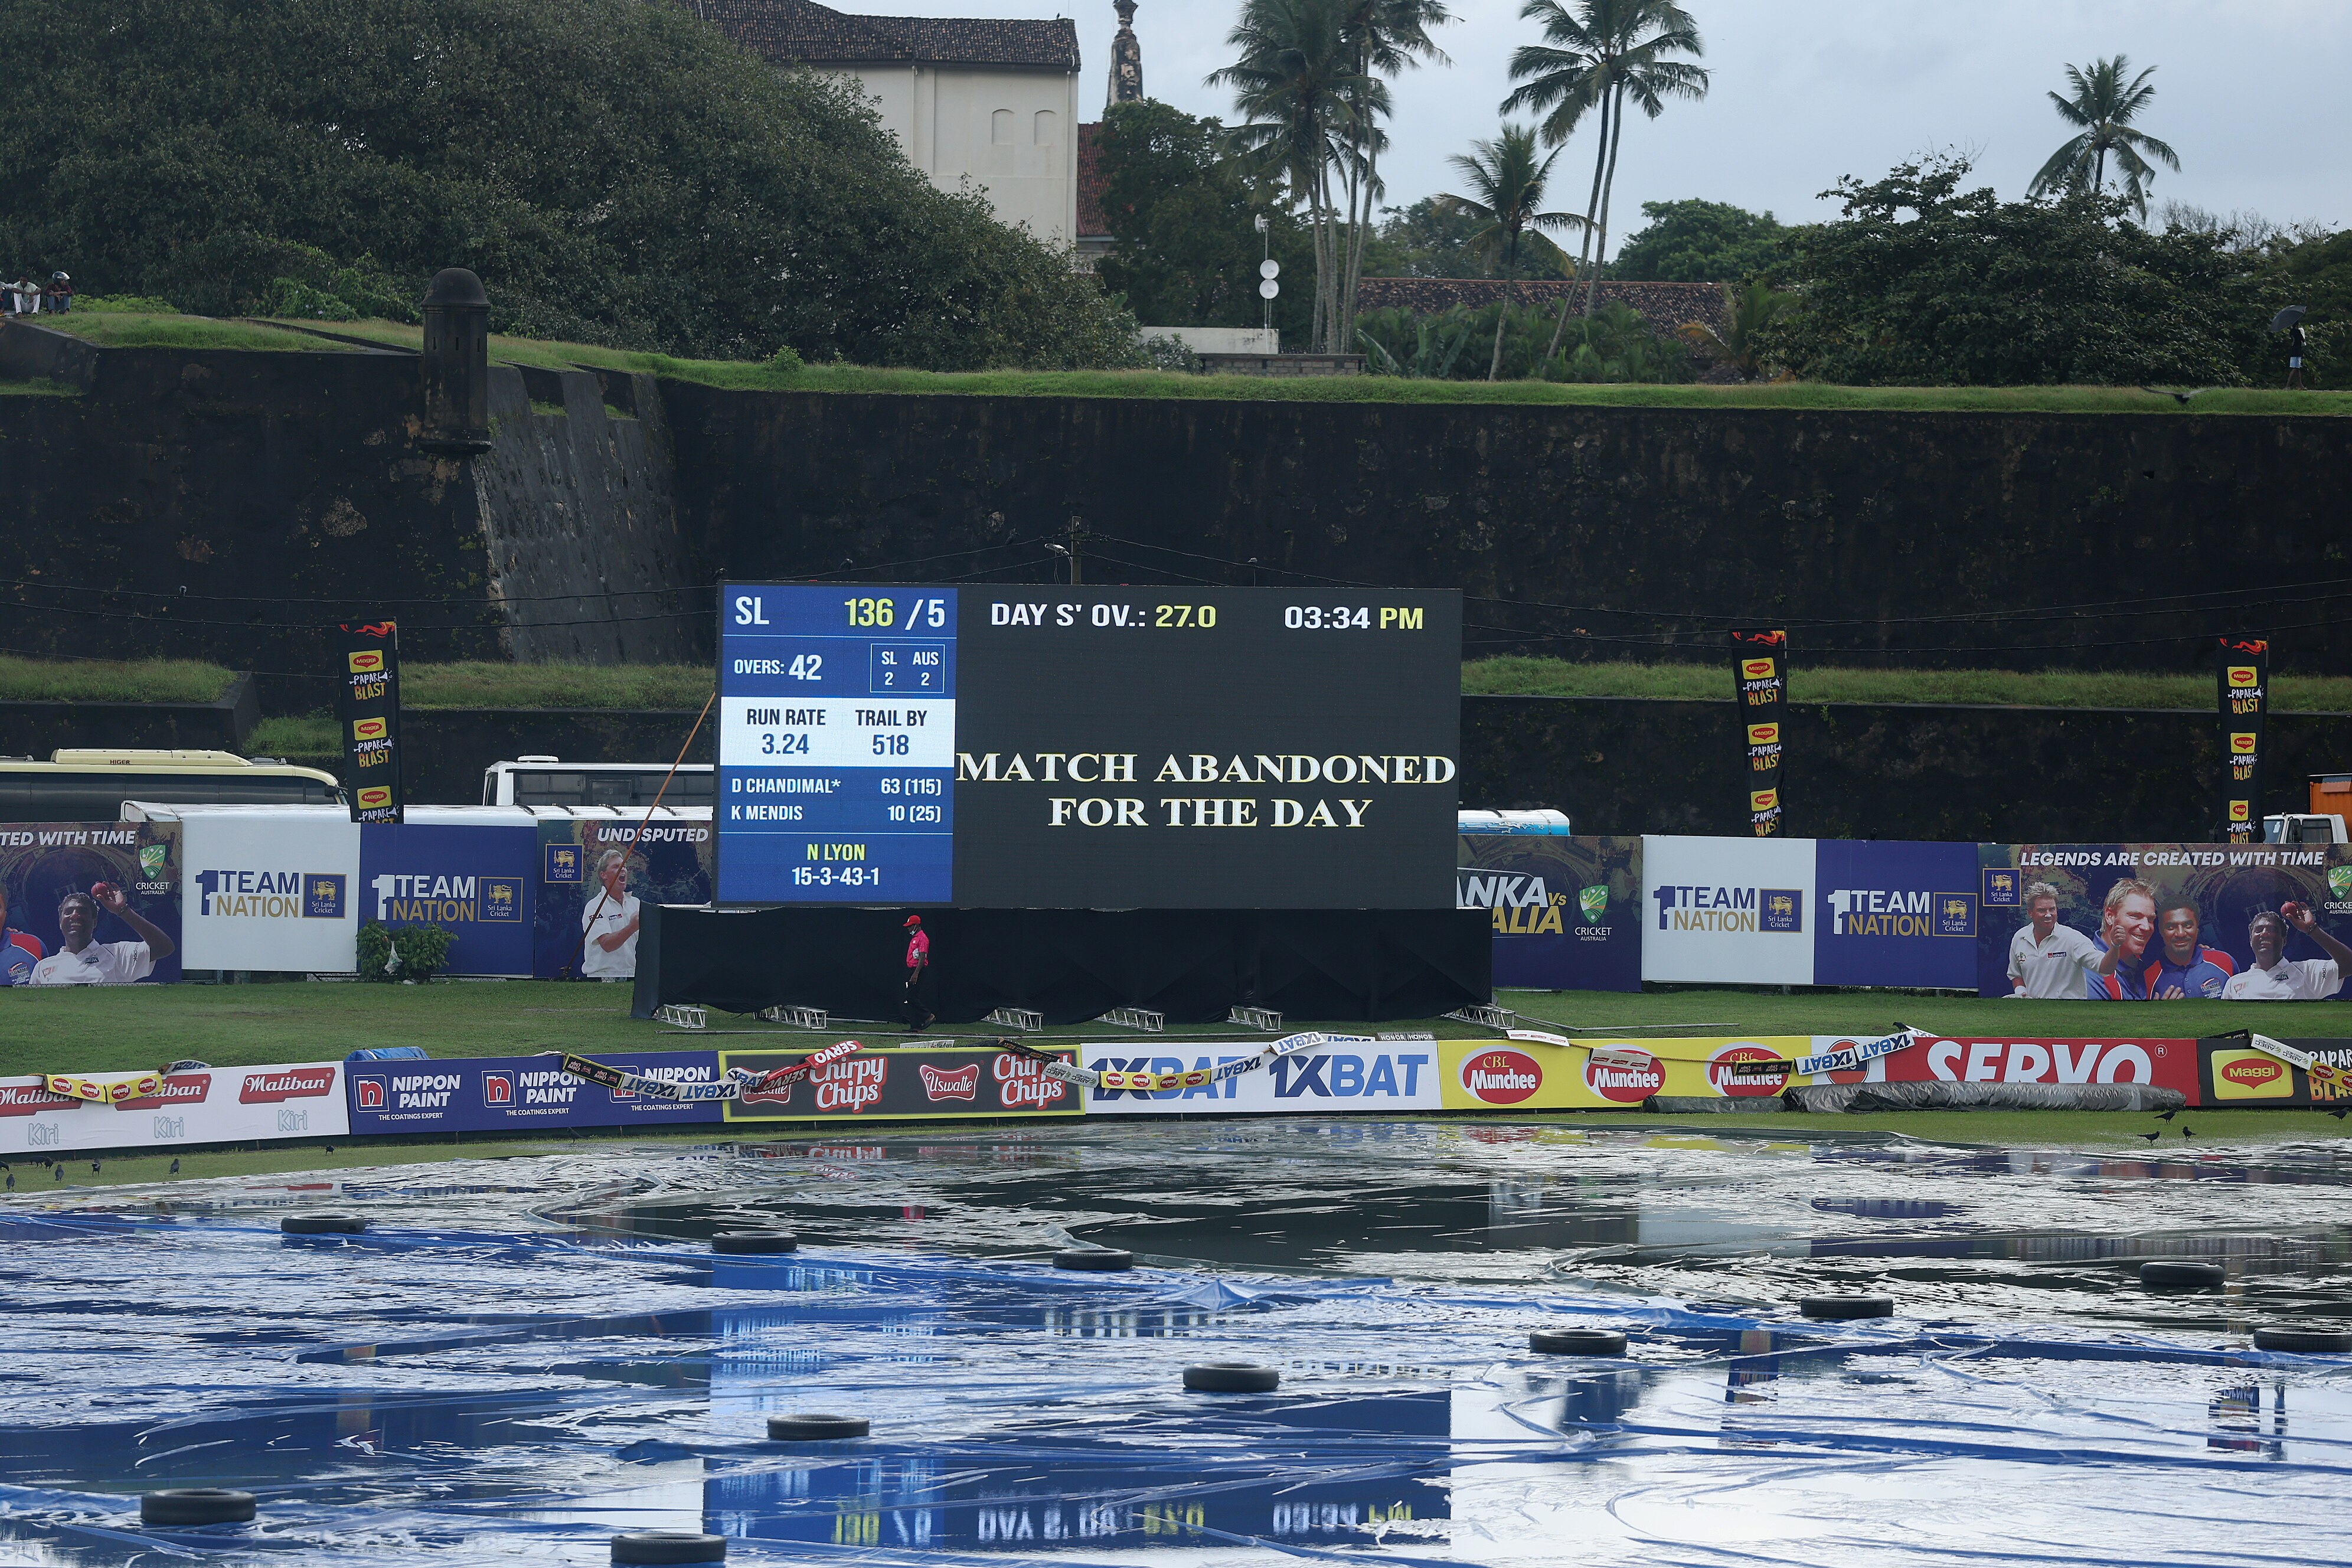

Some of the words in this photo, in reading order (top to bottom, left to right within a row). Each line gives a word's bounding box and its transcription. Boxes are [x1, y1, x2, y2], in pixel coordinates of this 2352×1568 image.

[735, 596, 769, 625] SL
[844, 598, 894, 627] 136
[905, 599, 945, 631] /5
[991, 603, 1047, 626] DAY
[1155, 605, 1217, 628] 27.0
[1285, 606, 1370, 630] 03:34
[1380, 607, 1423, 630] PM
[734, 659, 784, 674] OVERS:
[789, 655, 822, 681] 42
[881, 652, 897, 665] SL
[913, 652, 939, 665] AUS
[885, 672, 893, 685] 2
[921, 672, 929, 686] 2
[355, 682, 386, 701] BLAST
[1747, 689, 1778, 706] BLAST
[2232, 698, 2259, 714] BLAST
[747, 709, 780, 725] RUN
[786, 710, 826, 726] RATE
[855, 710, 901, 726] TRAIL
[907, 710, 927, 726] BY
[762, 733, 809, 754] 3.24
[873, 734, 909, 755] 518
[359, 750, 389, 767] BLAST
[1752, 754, 1780, 772] BLAST
[955, 753, 1138, 782] MATCH
[1154, 754, 1456, 784] ABANDONED
[732, 779, 741, 793] D
[881, 778, 900, 794] 63
[905, 778, 942, 796] (115)
[731, 806, 741, 820] K
[746, 806, 803, 821] MENDIS
[888, 806, 905, 821] 10
[910, 806, 941, 822] (25)
[1048, 798, 1149, 827] FOR
[1161, 798, 1257, 828] THE
[1270, 799, 1373, 828] DAY
[39, 831, 86, 845] WITH
[92, 830, 136, 844] TIME
[597, 828, 708, 842] UNDISPUTED
[807, 844, 819, 860] N
[825, 844, 865, 861] LYON
[2020, 852, 2101, 866] LEGENDS
[2103, 852, 2139, 865] ARE
[2144, 851, 2227, 865] CREATED
[2230, 851, 2278, 865] WITH
[2281, 851, 2324, 865] TIME
[220, 871, 299, 894] TEAM
[792, 867, 880, 886] 15-3-43-1
[396, 875, 475, 899] TEAM
[217, 895, 298, 917] NATION
[1676, 886, 1755, 909] TEAM
[1851, 890, 1929, 913] TEAM
[393, 900, 474, 922] NATION
[1674, 910, 1754, 932] NATION
[1848, 914, 1929, 936] NATION
[1575, 927, 1612, 936] CRICKET
[814, 1041, 857, 1063] SERVO
[1279, 1033, 1321, 1053] 1XBAT
[1861, 1034, 1910, 1059] 1XBAT
[2255, 1040, 2275, 1051] ABEC
[1482, 1056, 1510, 1068] CBL
[1802, 1051, 1852, 1073] 1XBAT
[1927, 1040, 2152, 1084] SERVO
[2282, 1051, 2302, 1063] ABEC
[645, 1066, 711, 1082] NIPPON
[1046, 1068, 1066, 1077] ABEC
[1214, 1057, 1261, 1080] 1XBAT
[1269, 1055, 1429, 1097] 1XBAT
[2229, 1066, 2275, 1077] Maggi
[54, 1081, 71, 1089] Munchee
[139, 1081, 156, 1089] Munchee
[245, 1074, 326, 1093] Maliban
[392, 1074, 460, 1092] NIPPON
[520, 1070, 586, 1087] NIPPON
[624, 1078, 677, 1098] 1XBAT
[763, 1068, 807, 1090] SERVO
[926, 1071, 973, 1092] Uswatte
[1072, 1075, 1090, 1084] ABEC
[1471, 1070, 1536, 1089] Munchee
[1593, 1069, 1660, 1088] Munchee
[81, 1086, 98, 1096] Munchee
[113, 1085, 129, 1095] Munchee
[525, 1087, 576, 1104] PAINT
[683, 1084, 736, 1099] 1XBAT
[817, 1080, 878, 1110] Chips
[1001, 1077, 1062, 1108] Chips
[400, 1092, 450, 1108] PAINT
[154, 1116, 184, 1139] Kiri
[277, 1109, 308, 1132] Kiri
[28, 1123, 59, 1146] Kiri
